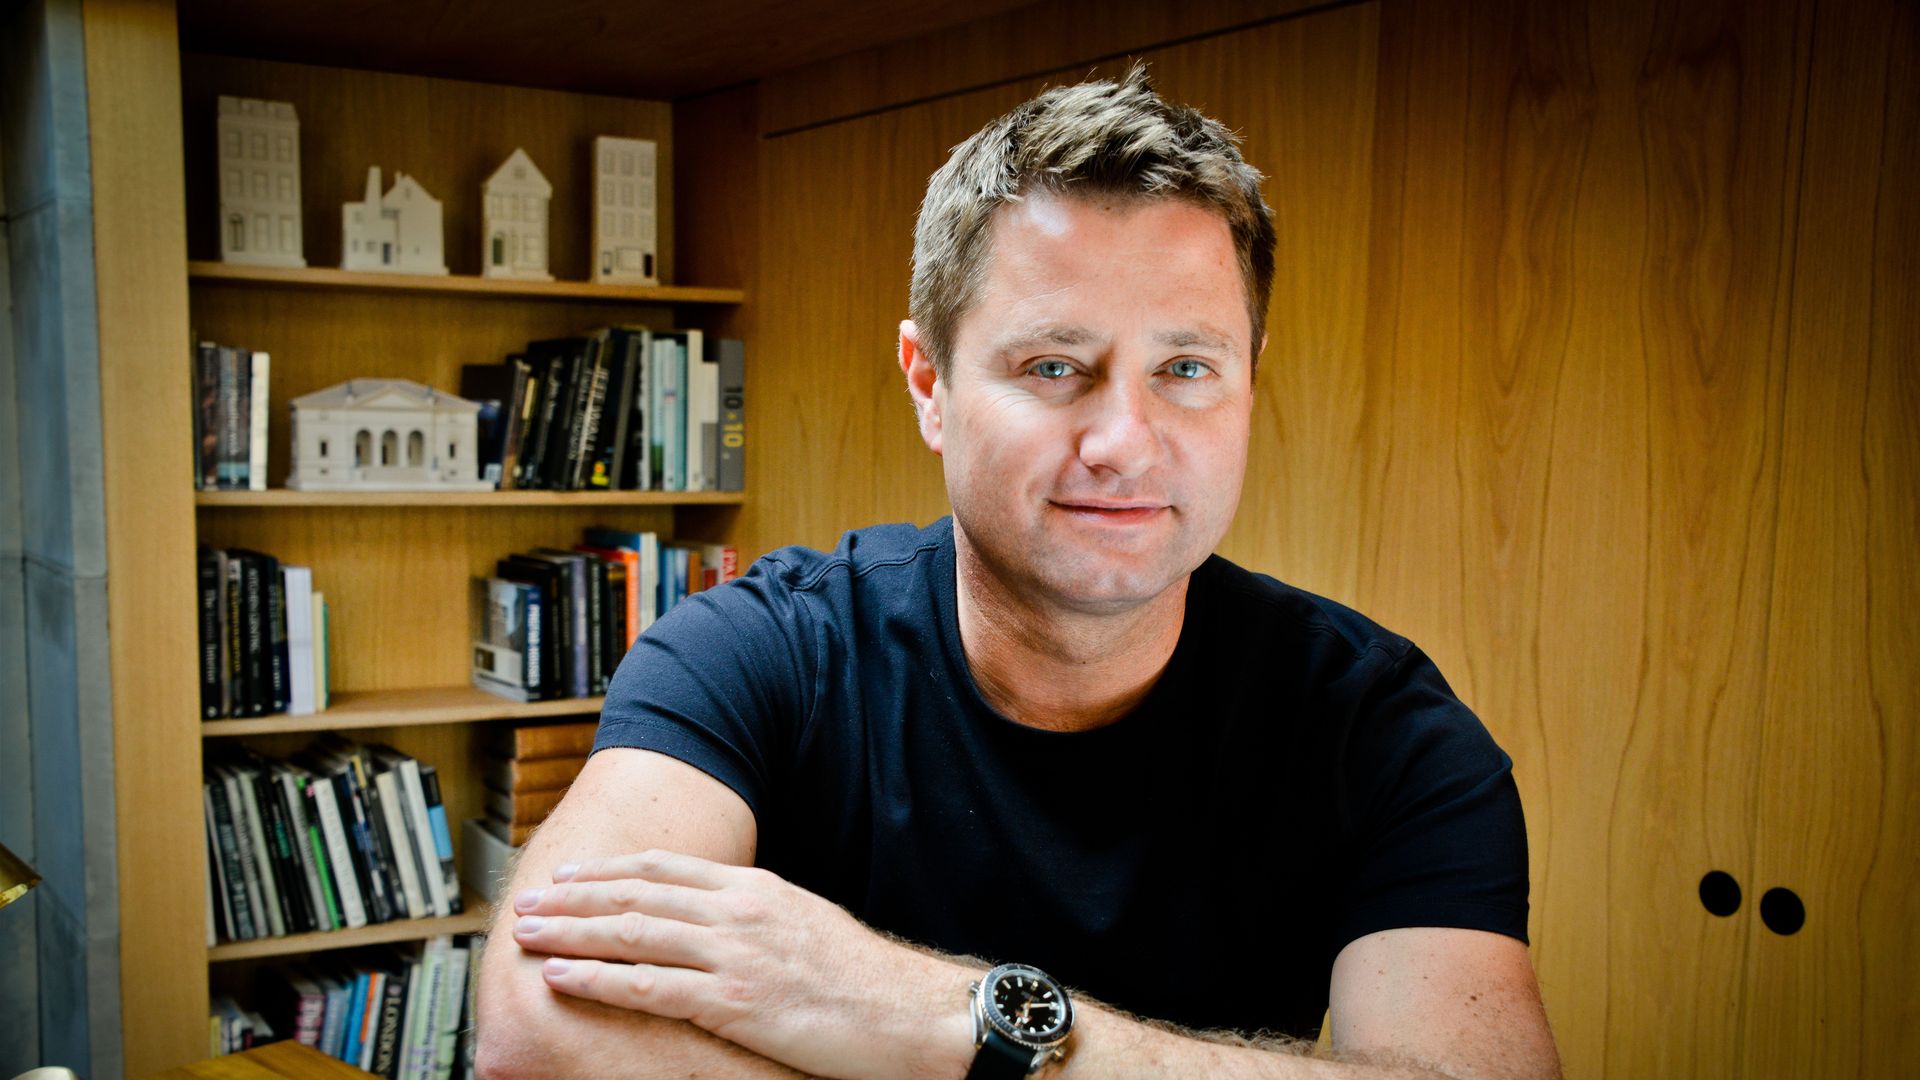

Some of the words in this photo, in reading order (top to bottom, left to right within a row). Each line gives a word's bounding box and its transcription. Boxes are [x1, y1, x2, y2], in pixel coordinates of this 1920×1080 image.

[723, 386, 744, 409] 10
[722, 423, 745, 448] 10
[376, 998, 401, 1072] LONDON
